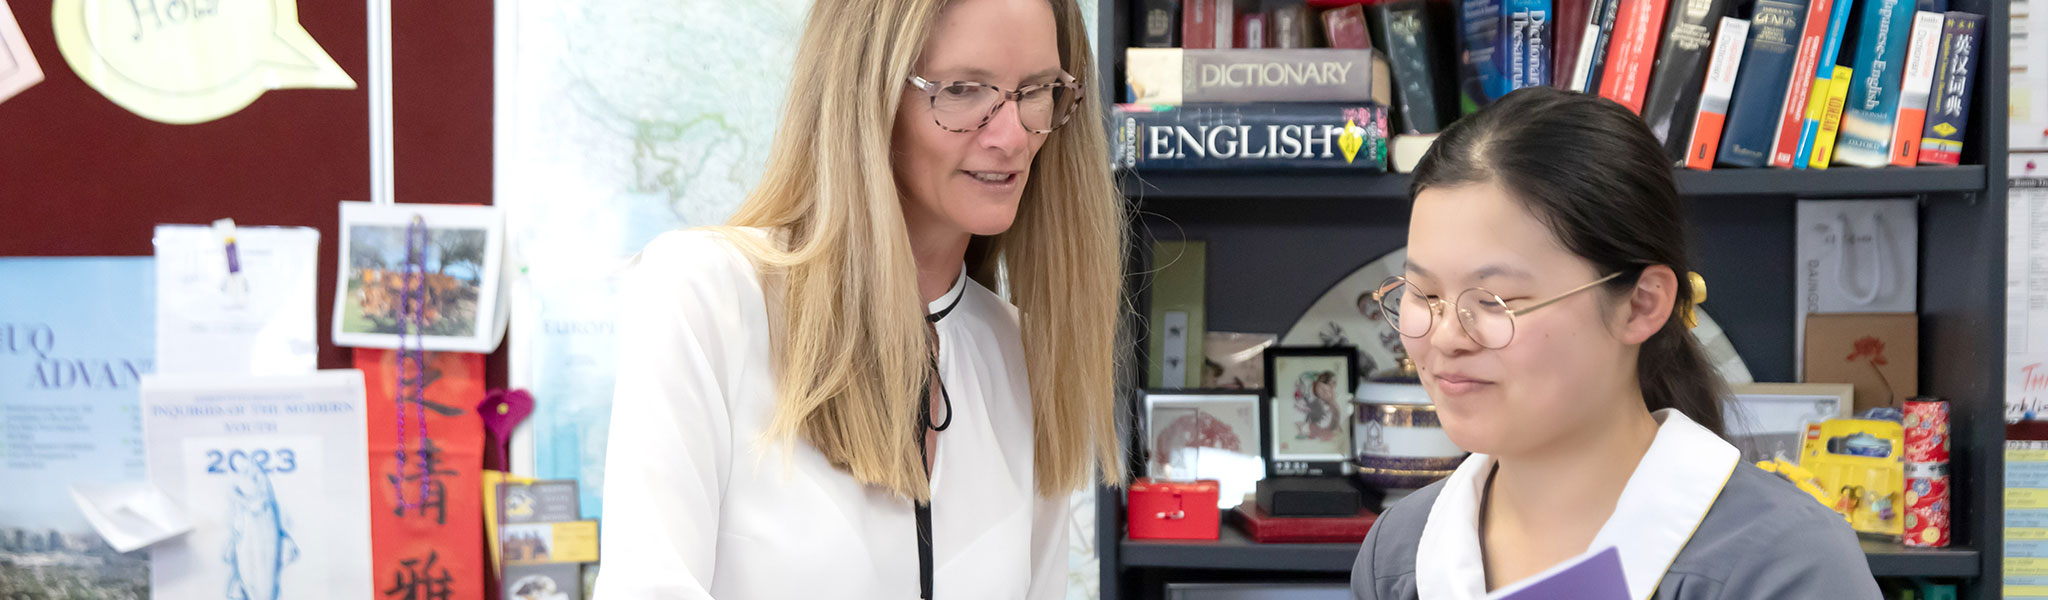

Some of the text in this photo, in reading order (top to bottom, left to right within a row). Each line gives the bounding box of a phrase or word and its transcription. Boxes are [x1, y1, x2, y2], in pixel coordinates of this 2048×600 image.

[1755, 12, 1797, 27] GENUS
[1711, 35, 1731, 81] Dictionary
[1909, 30, 1927, 77] Dictionary
[1201, 61, 1353, 88] DICTIONARY
[1945, 33, 1973, 118] 英汉词典
[1823, 97, 1842, 132] KOREAN
[1148, 124, 1335, 160] ENGLISH
[206, 449, 298, 475] 2023
